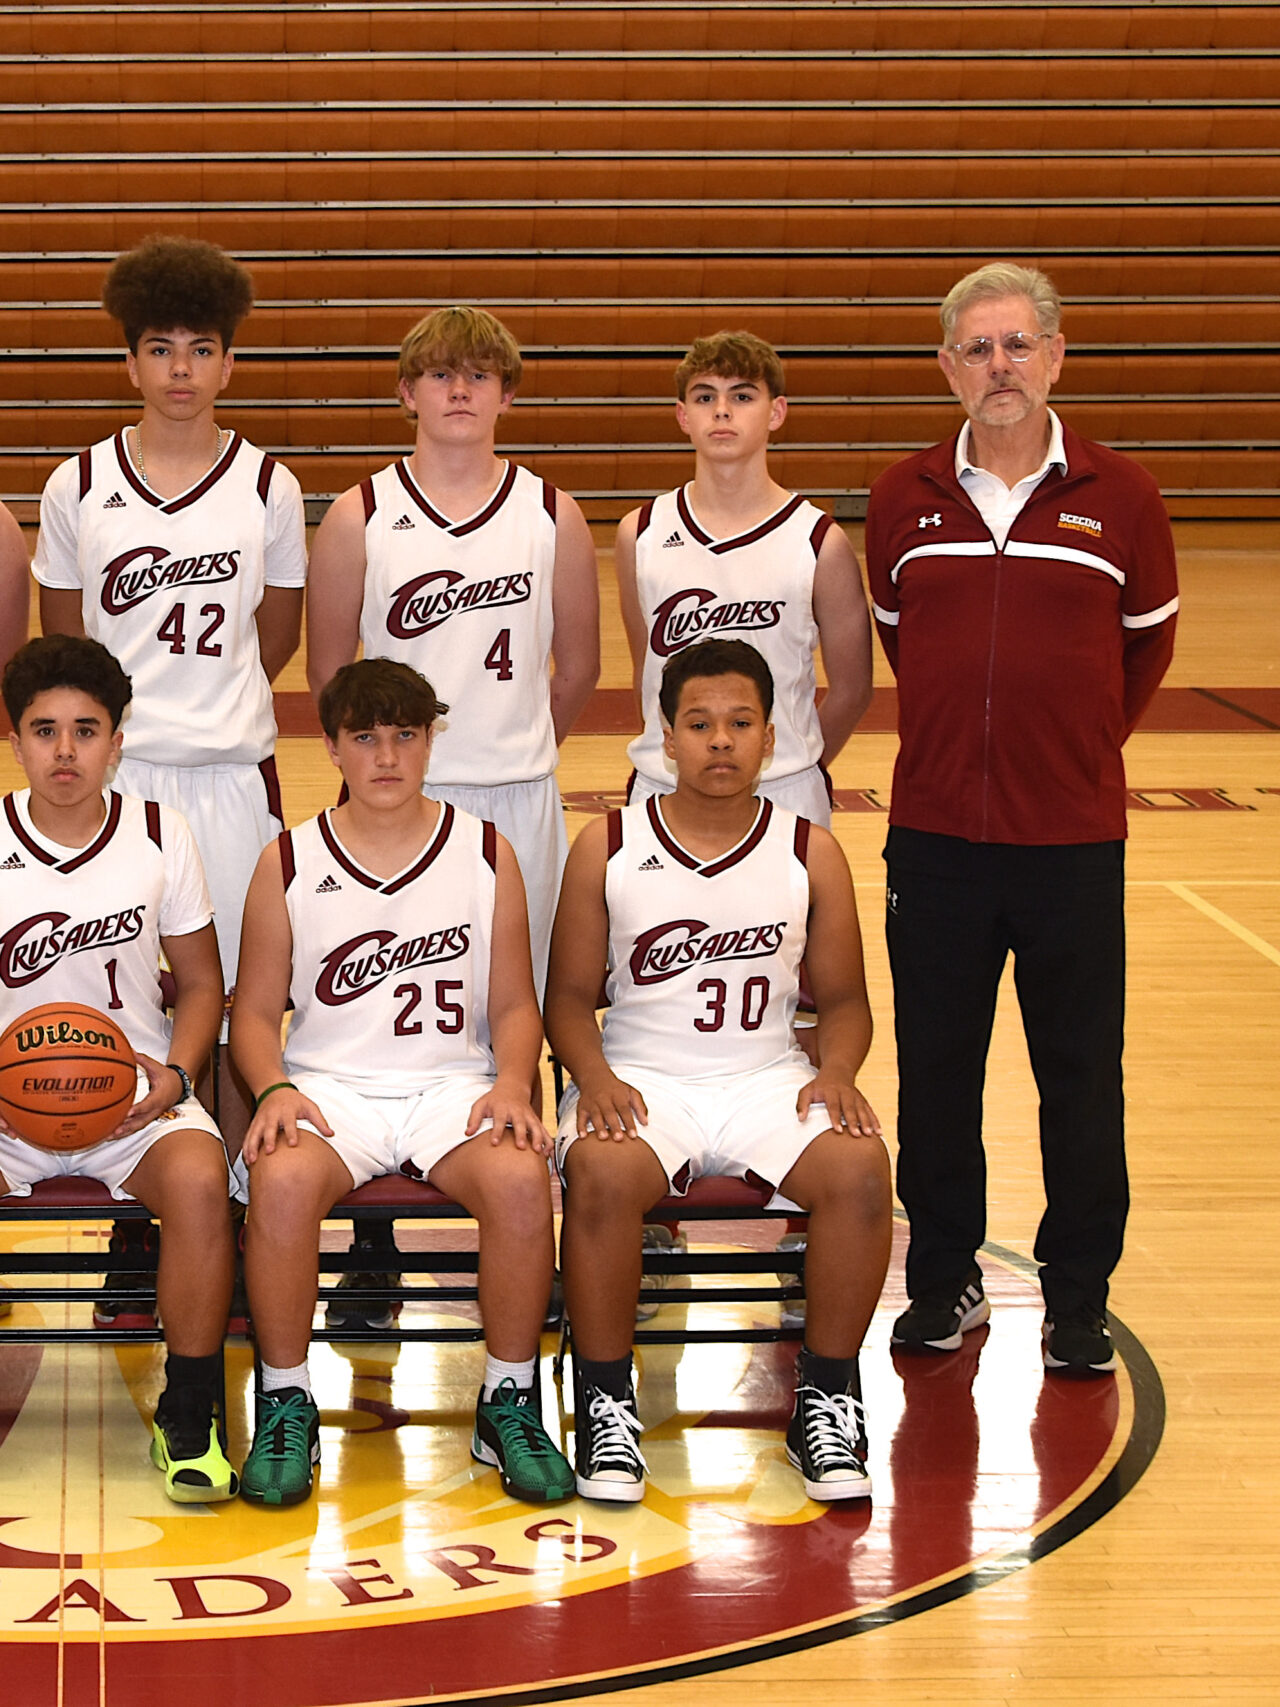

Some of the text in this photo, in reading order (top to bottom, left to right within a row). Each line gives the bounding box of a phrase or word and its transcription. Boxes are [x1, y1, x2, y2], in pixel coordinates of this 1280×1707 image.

[100, 545, 241, 616] CRUSADERS
[386, 570, 534, 640] CRUSADERS
[156, 602, 227, 657] 42
[650, 587, 787, 657] CRUSADERS
[483, 628, 514, 681] 4
[314, 923, 472, 1007] CRUSADERS
[629, 920, 787, 987] CRUSADERS
[103, 958, 125, 1010] 1
[392, 978, 465, 1037] 25
[693, 976, 772, 1033] 30
[15, 1021, 118, 1053] Wilson
[22, 1075, 115, 1092] EVOLUTION
